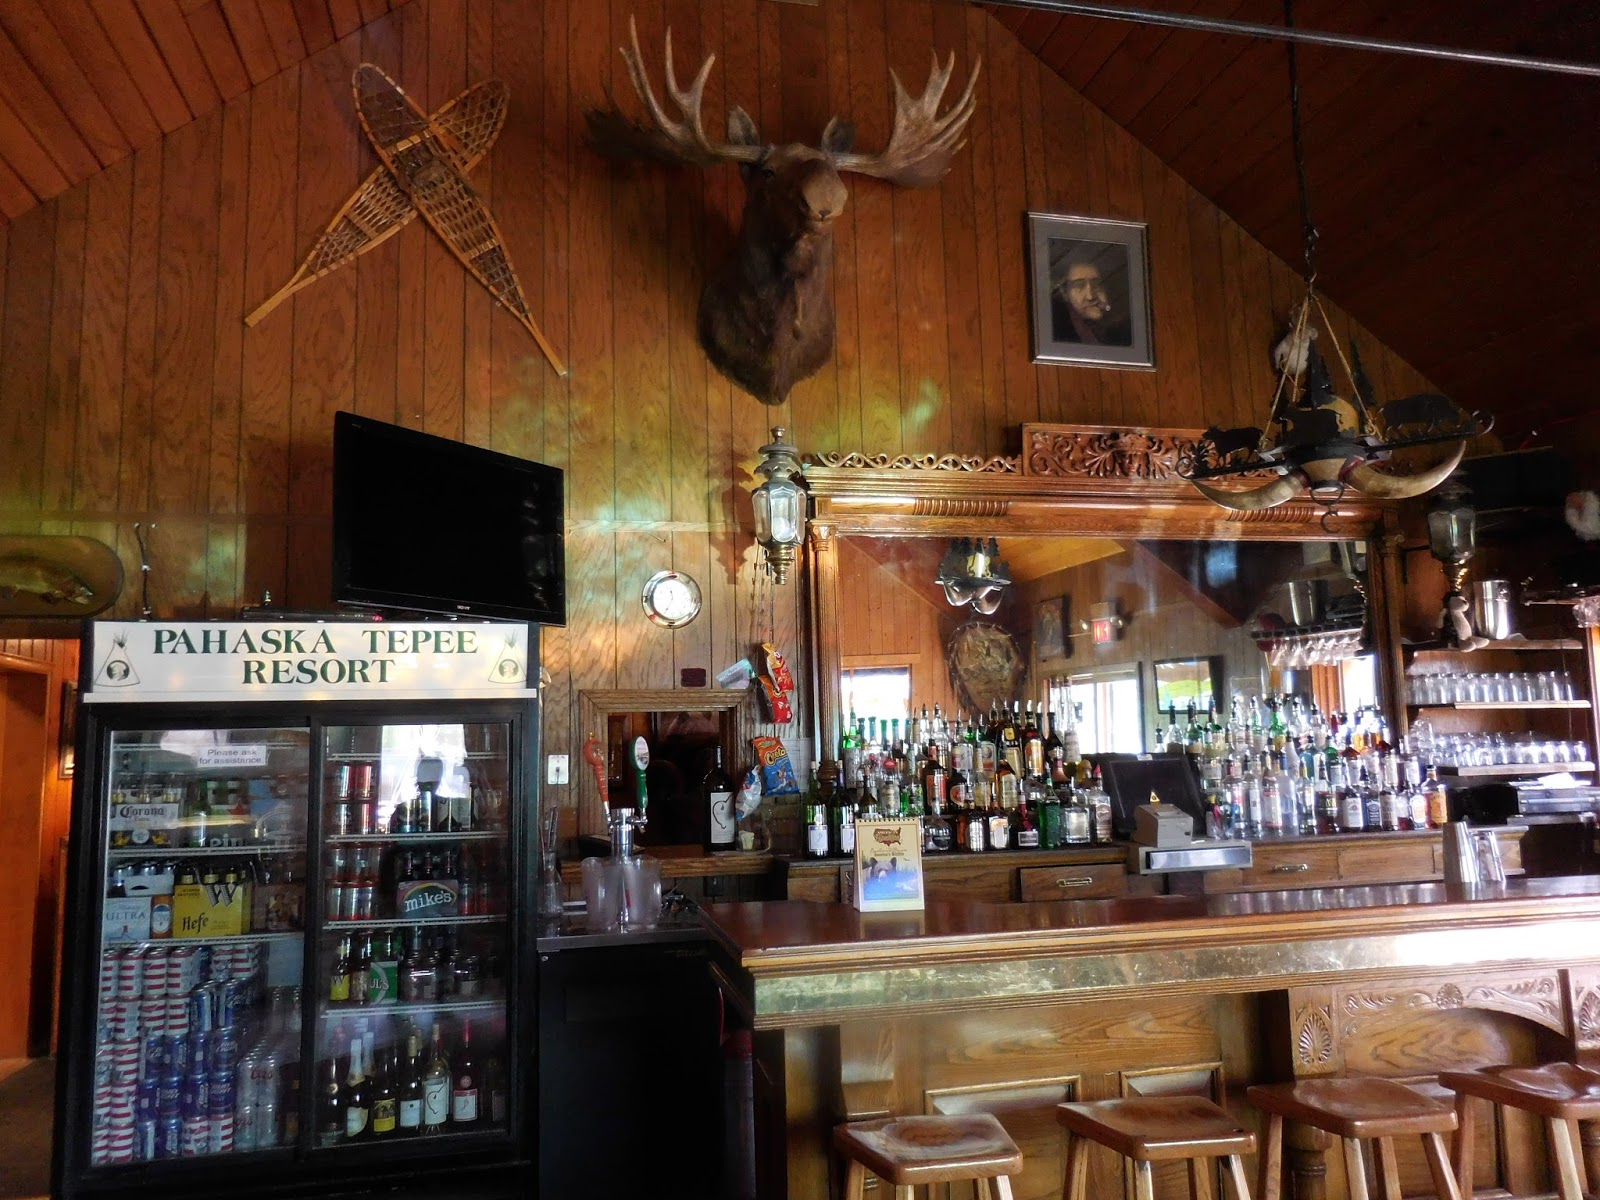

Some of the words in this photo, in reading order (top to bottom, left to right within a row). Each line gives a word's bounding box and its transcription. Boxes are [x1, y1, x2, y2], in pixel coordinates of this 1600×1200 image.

[153, 628, 337, 654] PAHASKA
[361, 630, 478, 654] TEPEE
[241, 658, 396, 684] RESORT
[199, 757, 212, 765] for
[207, 748, 239, 757] Please
[120, 805, 165, 819] Corona
[204, 883, 238, 907] W
[404, 890, 452, 912] mike's
[106, 911, 147, 920] ULTRA
[182, 912, 209, 934] Hefe
